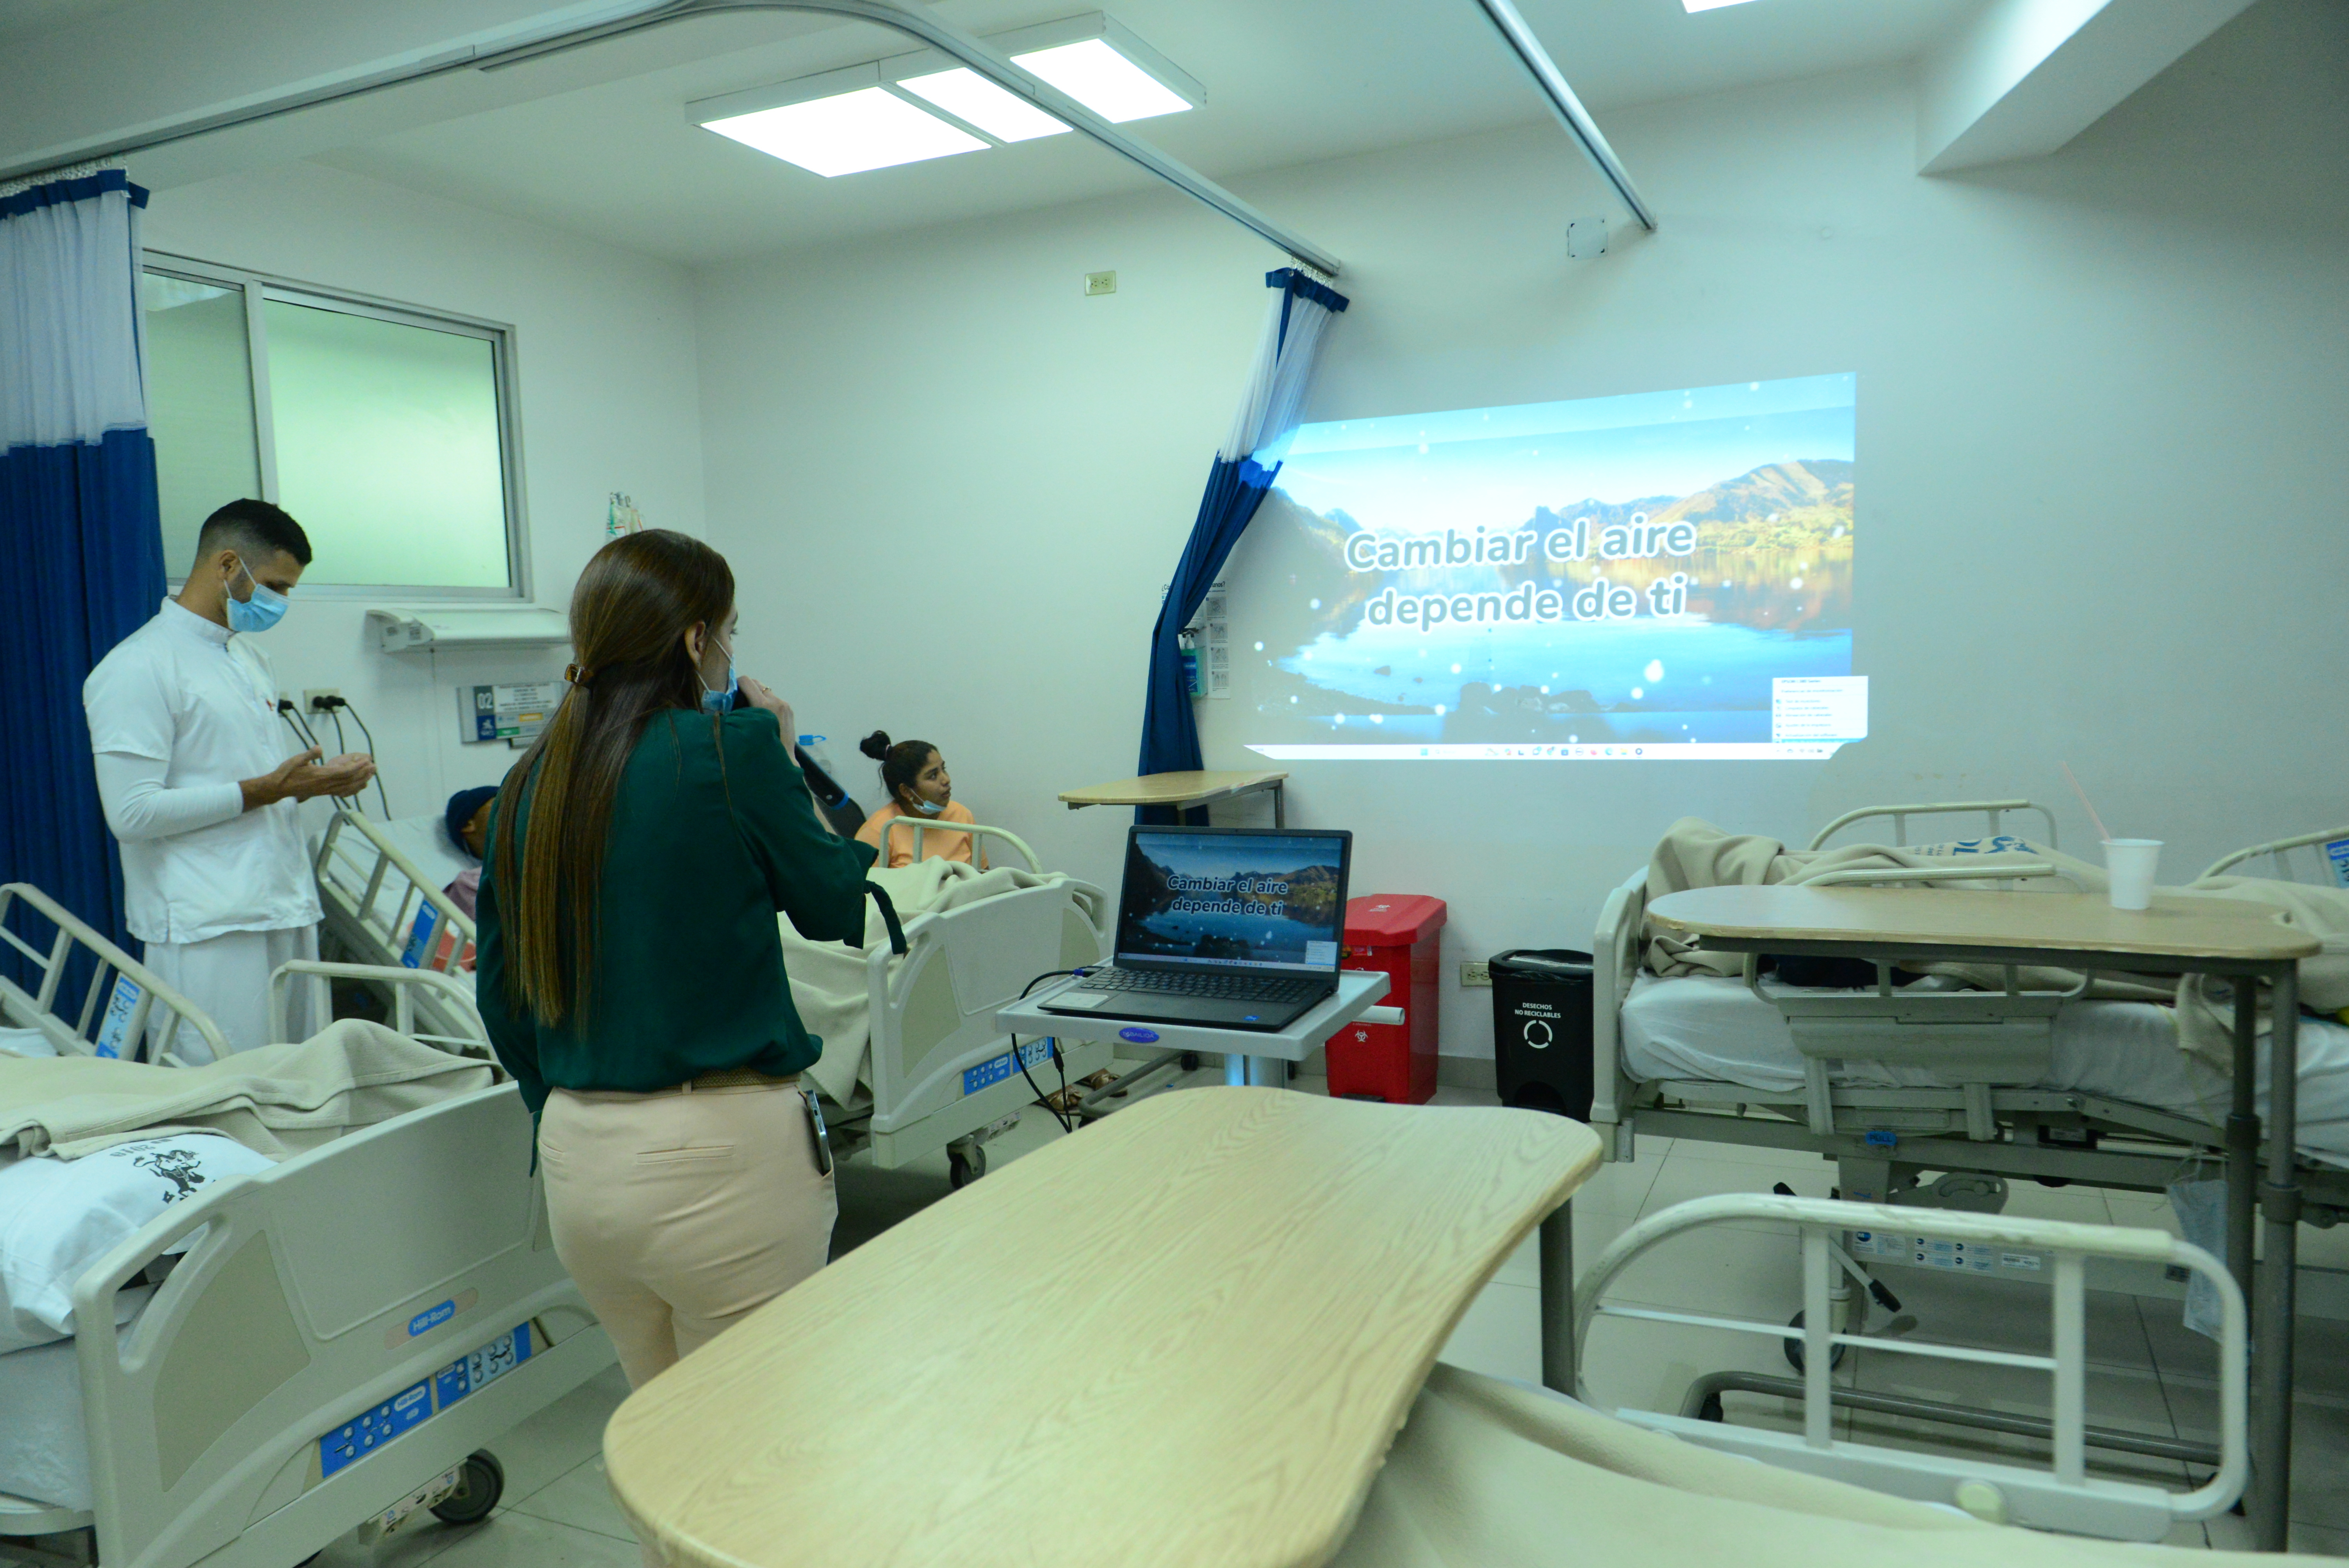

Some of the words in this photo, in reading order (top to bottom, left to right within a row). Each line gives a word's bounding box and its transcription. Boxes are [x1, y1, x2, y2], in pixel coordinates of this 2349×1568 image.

[1348, 526, 1535, 569] Cambiar
[1548, 520, 1587, 559] el
[1602, 515, 1695, 556] aire
[1368, 583, 1560, 632] depende
[1576, 580, 1635, 619] de
[1649, 575, 1684, 615] ti
[477, 693, 494, 709] 02
[1167, 875, 1235, 892] Cambiar
[1238, 877, 1253, 893] el
[1256, 878, 1288, 894] aire
[1172, 897, 1241, 914] depende
[1245, 900, 1266, 916] de
[1270, 900, 1283, 916] ti
[413, 1306, 451, 1332] Hill-Rom
